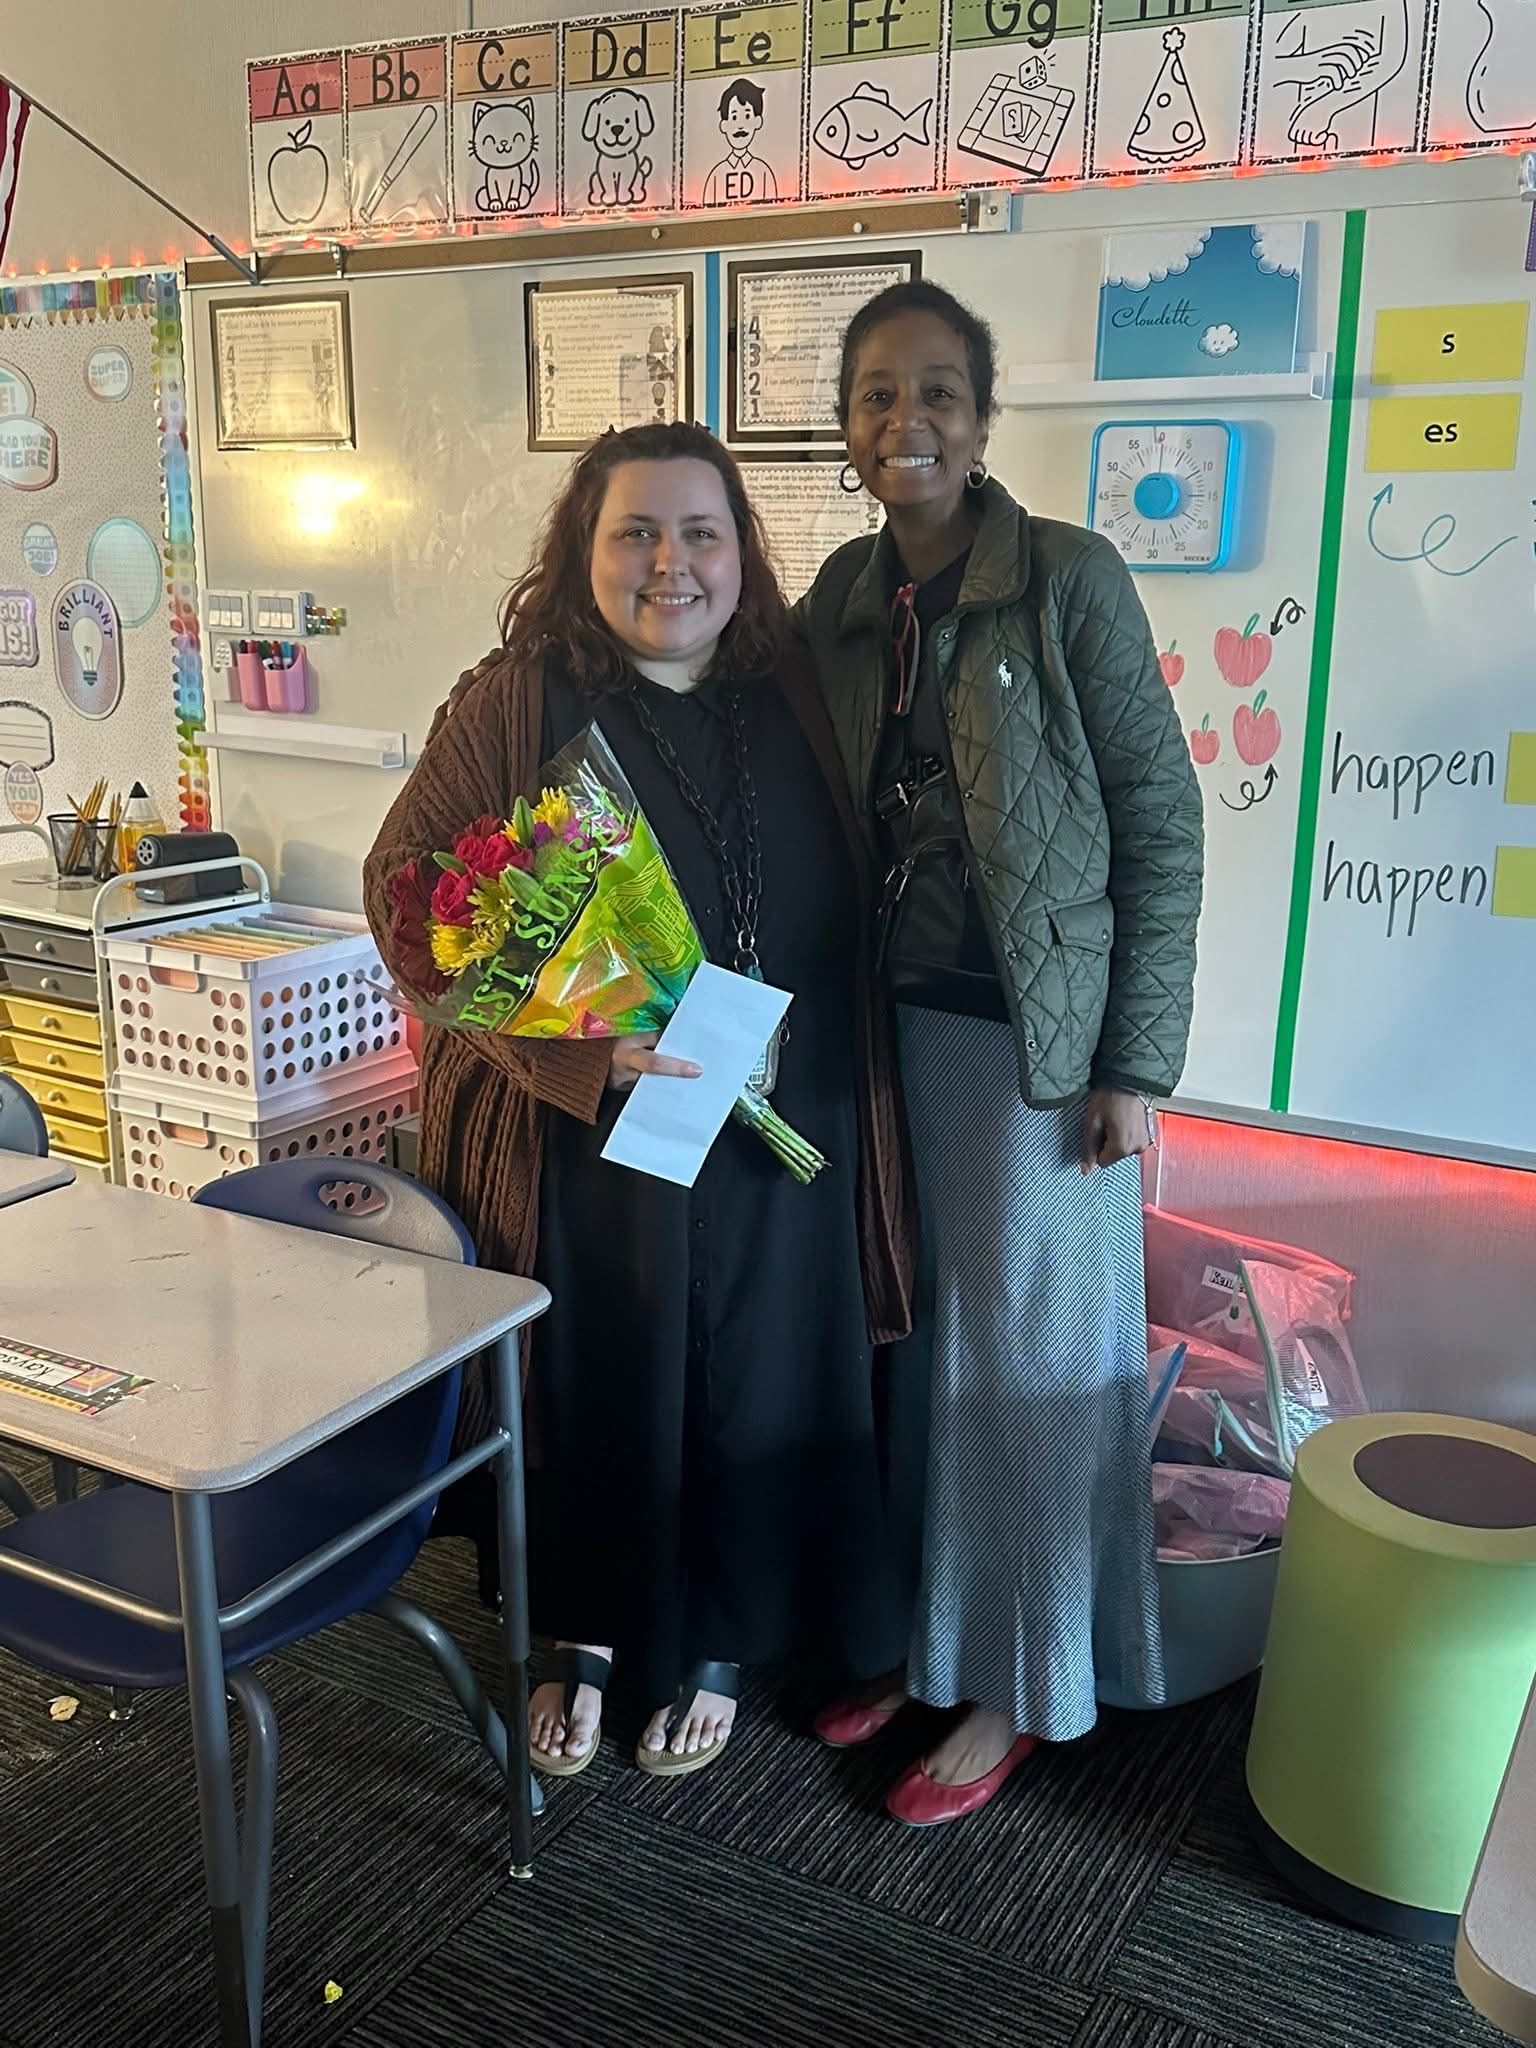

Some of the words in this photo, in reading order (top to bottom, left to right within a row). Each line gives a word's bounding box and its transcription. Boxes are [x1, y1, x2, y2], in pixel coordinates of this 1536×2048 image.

[714, 12, 772, 67] Ee
[848, 0, 906, 53] Ff
[591, 22, 647, 81] Dd
[371, 50, 421, 105] Bb
[477, 40, 532, 92] Cc
[271, 67, 321, 117] Aa
[725, 172, 754, 199] ED
[1112, 296, 1200, 328] Cloudette
[1441, 332, 1456, 354] s
[0, 434, 18, 449] LAD
[1128, 440, 1140, 450] 55
[1424, 422, 1458, 443] es
[1107, 462, 1119, 472] 50
[1203, 461, 1213, 471] 10
[1098, 491, 1110, 501] 45
[1102, 519, 1114, 529] 40
[1146, 549, 1158, 559] 30
[58, 589, 113, 638] BRILLIANT
[1331, 730, 1494, 820] happen
[8, 785, 38, 801] YOU
[1322, 840, 1487, 938] happen
